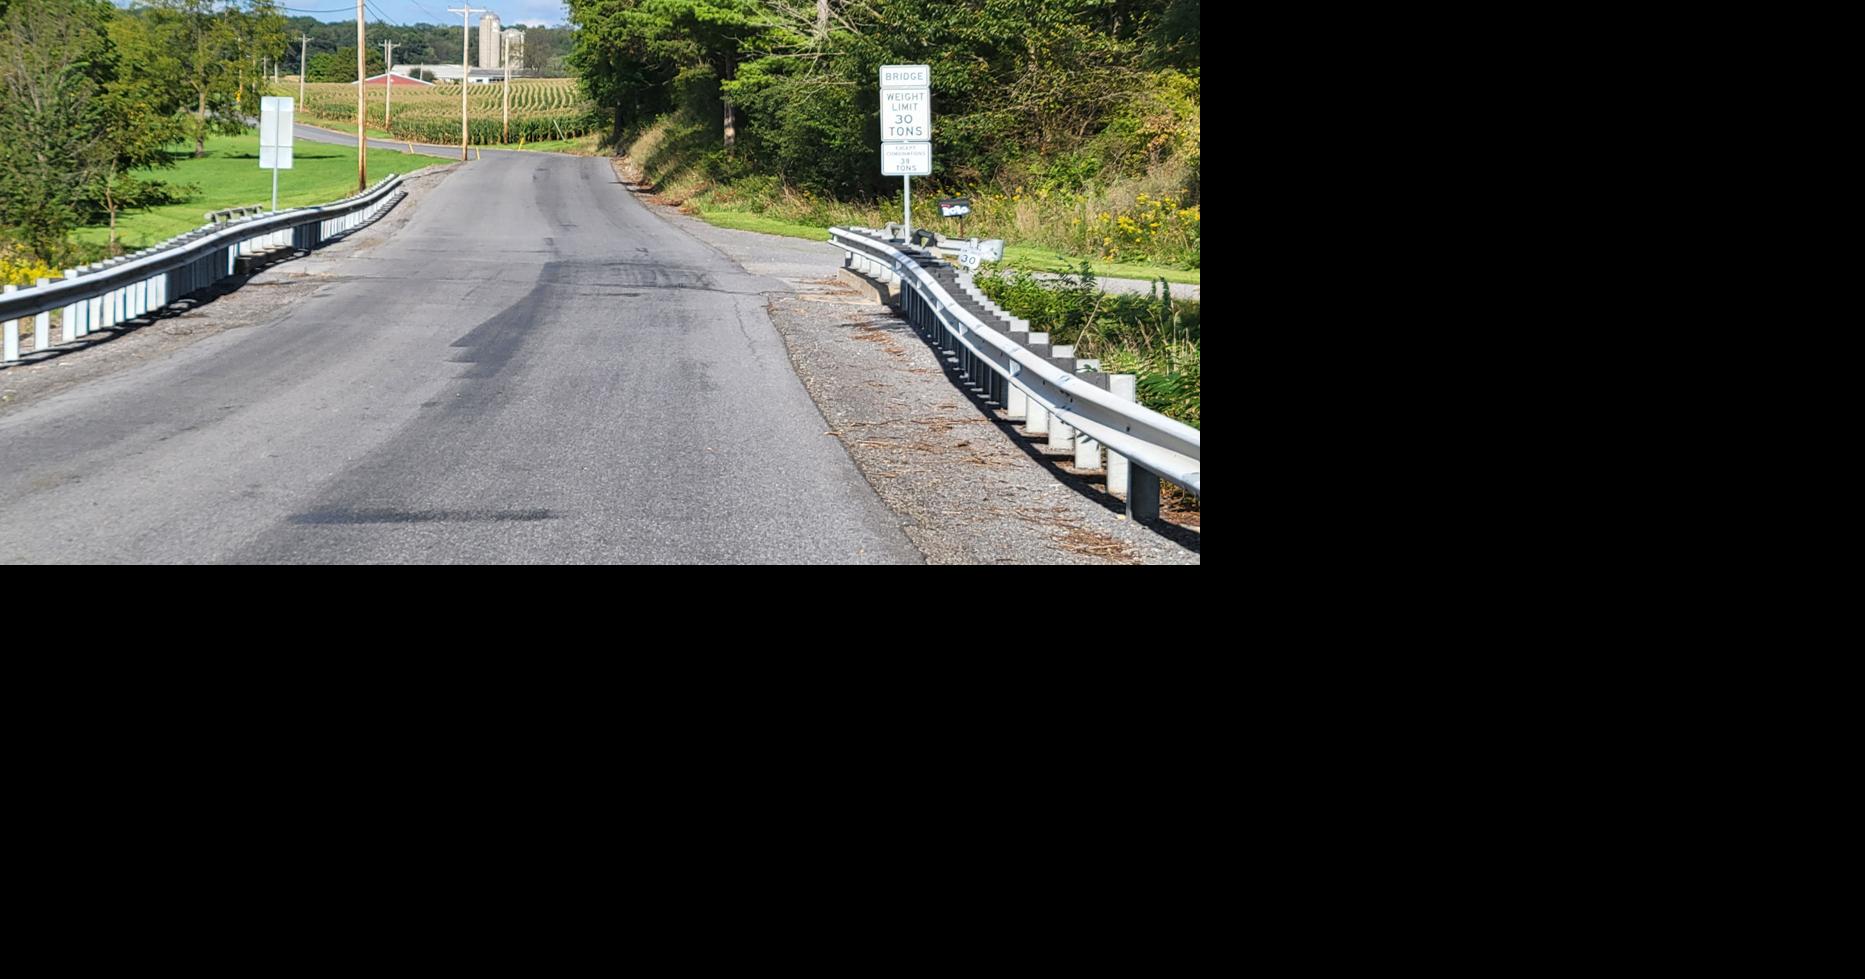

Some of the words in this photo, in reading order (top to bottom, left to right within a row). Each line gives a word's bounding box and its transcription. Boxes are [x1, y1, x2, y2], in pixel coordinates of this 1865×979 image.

[885, 72, 924, 81] BRIDGE
[886, 92, 925, 101] WEIGHT
[892, 102, 918, 111] LIMIT
[894, 114, 913, 124] 30
[889, 126, 923, 136] TONS
[960, 254, 976, 265] 30
